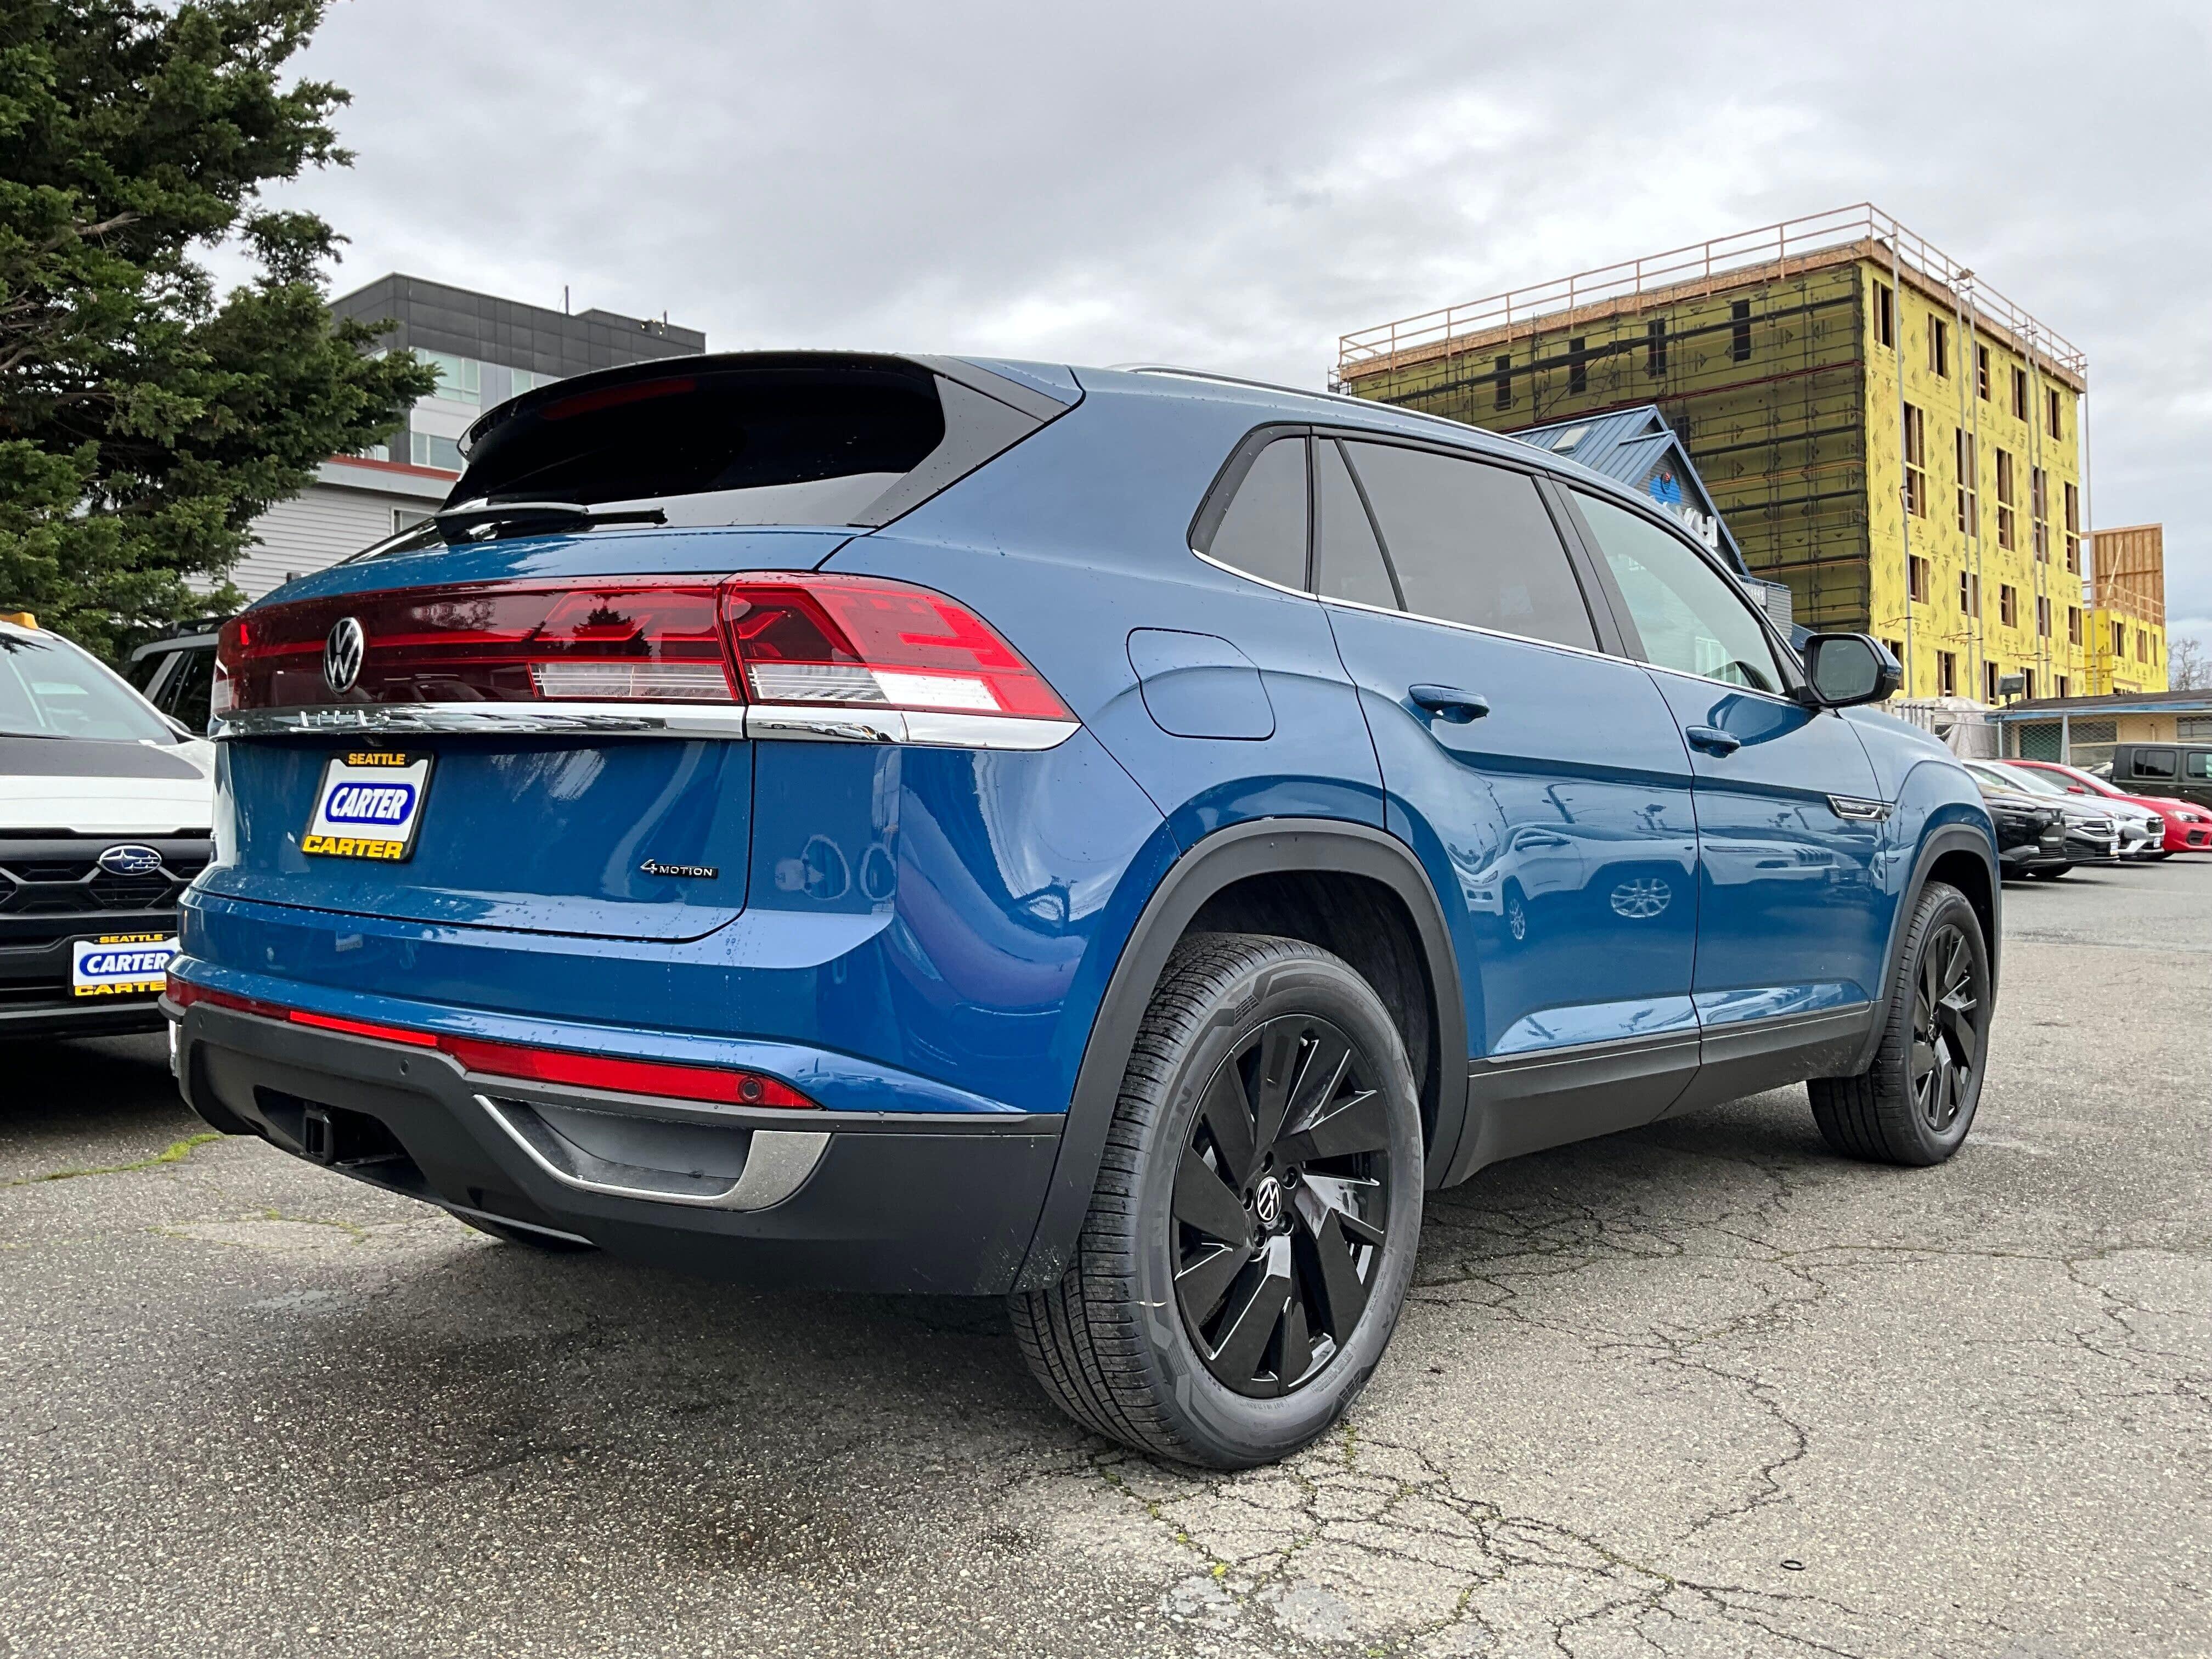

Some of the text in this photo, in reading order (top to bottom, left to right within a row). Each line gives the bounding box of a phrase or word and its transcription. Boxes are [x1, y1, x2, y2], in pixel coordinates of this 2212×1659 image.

[348, 753, 405, 765] SEATTLE
[330, 787, 409, 820] CARTER
[303, 835, 404, 859] CARTER
[640, 859, 713, 876] 4MOTION
[99, 934, 163, 944] SEATTLE
[87, 952, 170, 973] CARTER
[75, 980, 167, 996] CARTE
